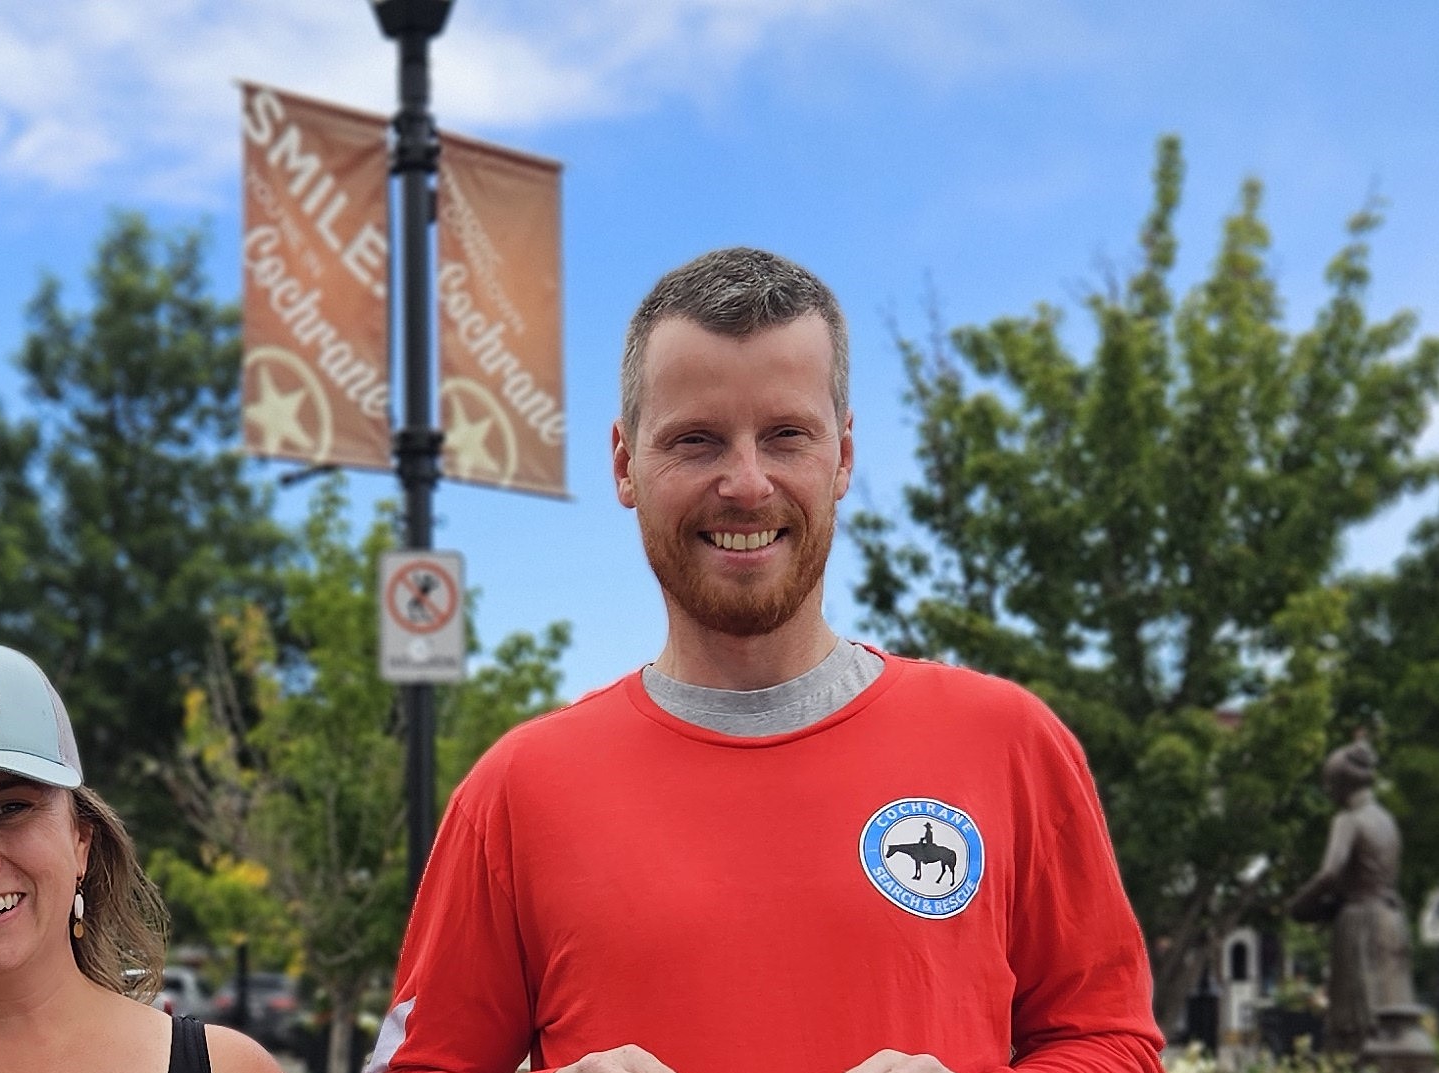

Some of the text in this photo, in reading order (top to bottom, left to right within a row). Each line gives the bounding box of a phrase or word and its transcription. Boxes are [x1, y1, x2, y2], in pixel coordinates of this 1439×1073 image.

[244, 91, 387, 298] SMILE.
[244, 226, 389, 417] Cochrane
[438, 262, 564, 446] Cochrane
[873, 866, 978, 913] SEARCH & RESCUE
[875, 802, 974, 834] COCHRANE
